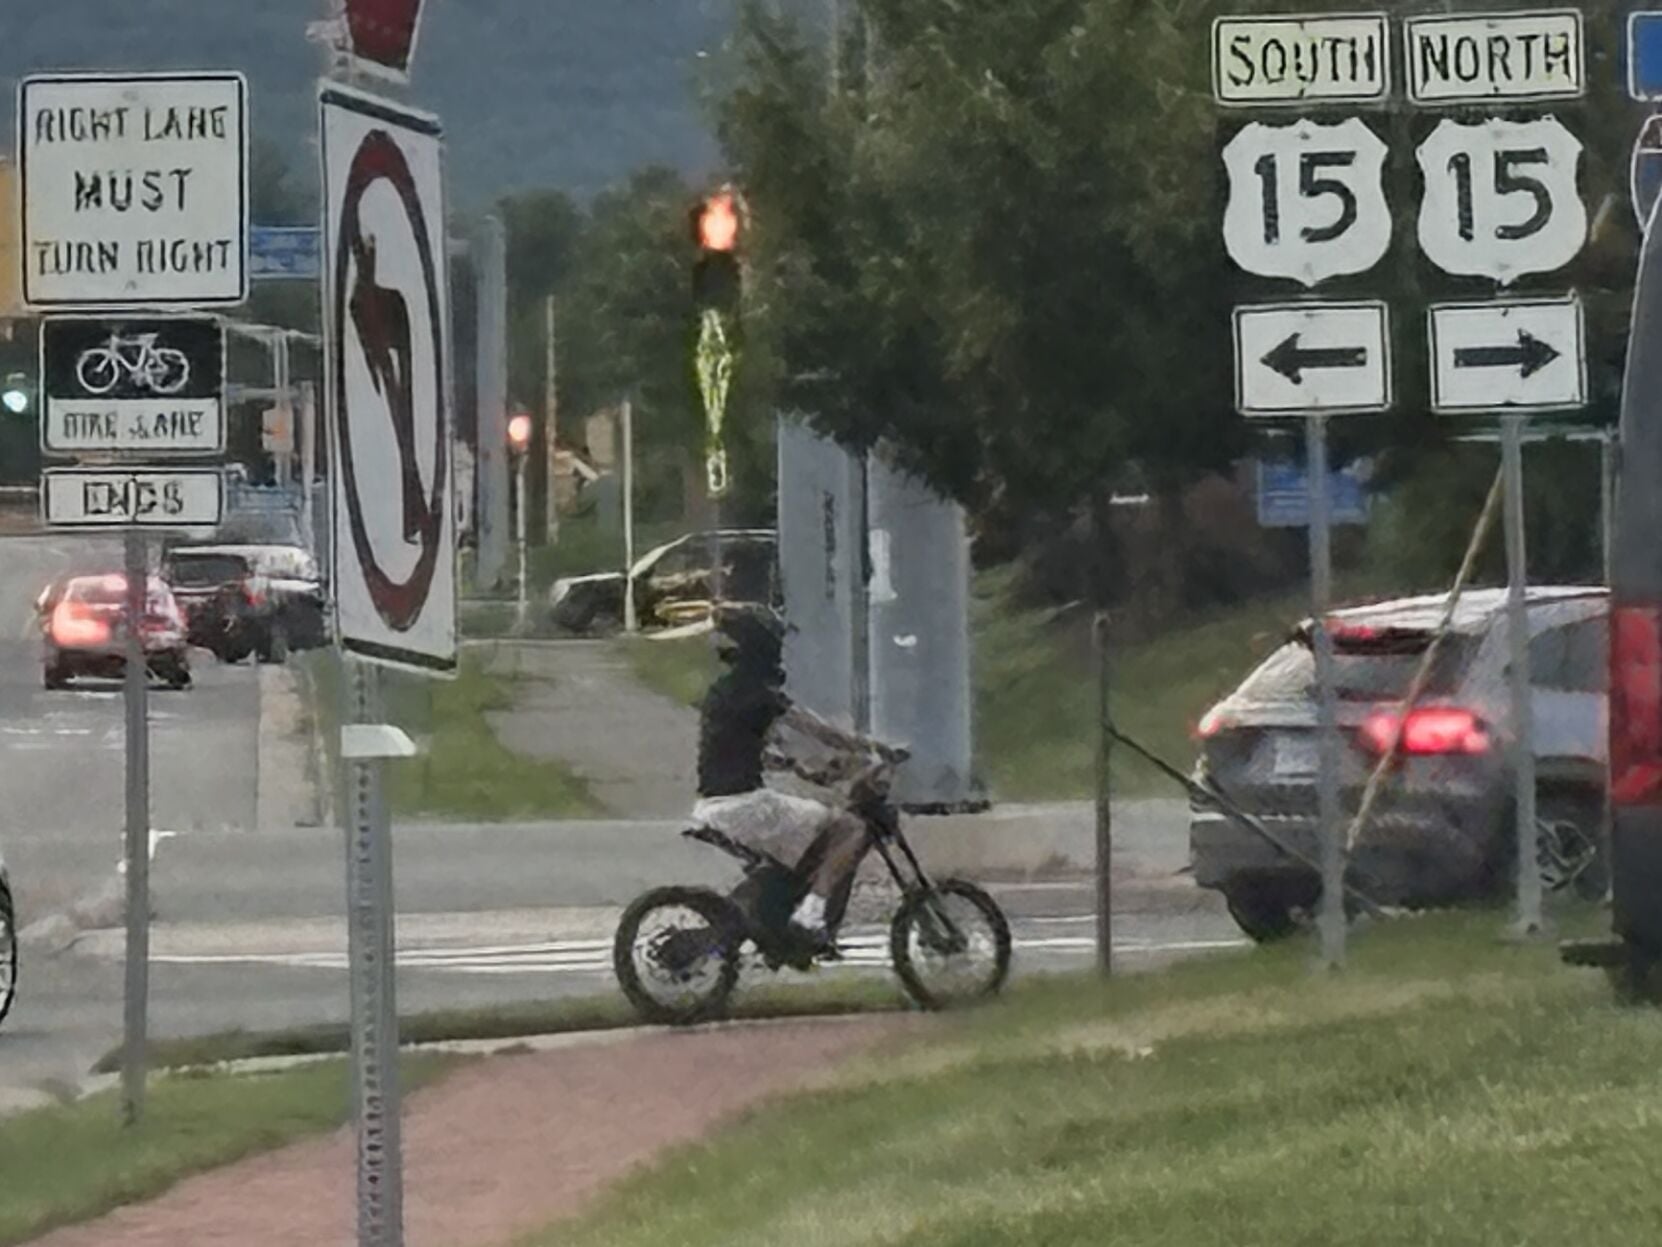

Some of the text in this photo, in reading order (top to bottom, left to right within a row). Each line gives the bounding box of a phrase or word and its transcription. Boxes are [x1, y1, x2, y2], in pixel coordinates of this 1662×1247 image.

[1228, 35, 1375, 86] SOUTH
[1420, 33, 1571, 82] NORTH
[35, 105, 228, 144] RIGHT LANE
[74, 168, 192, 212] MUST
[1254, 150, 1357, 244] 15
[1447, 147, 1553, 241] 15
[34, 241, 119, 275] TURN
[136, 239, 231, 273] RIGHT
